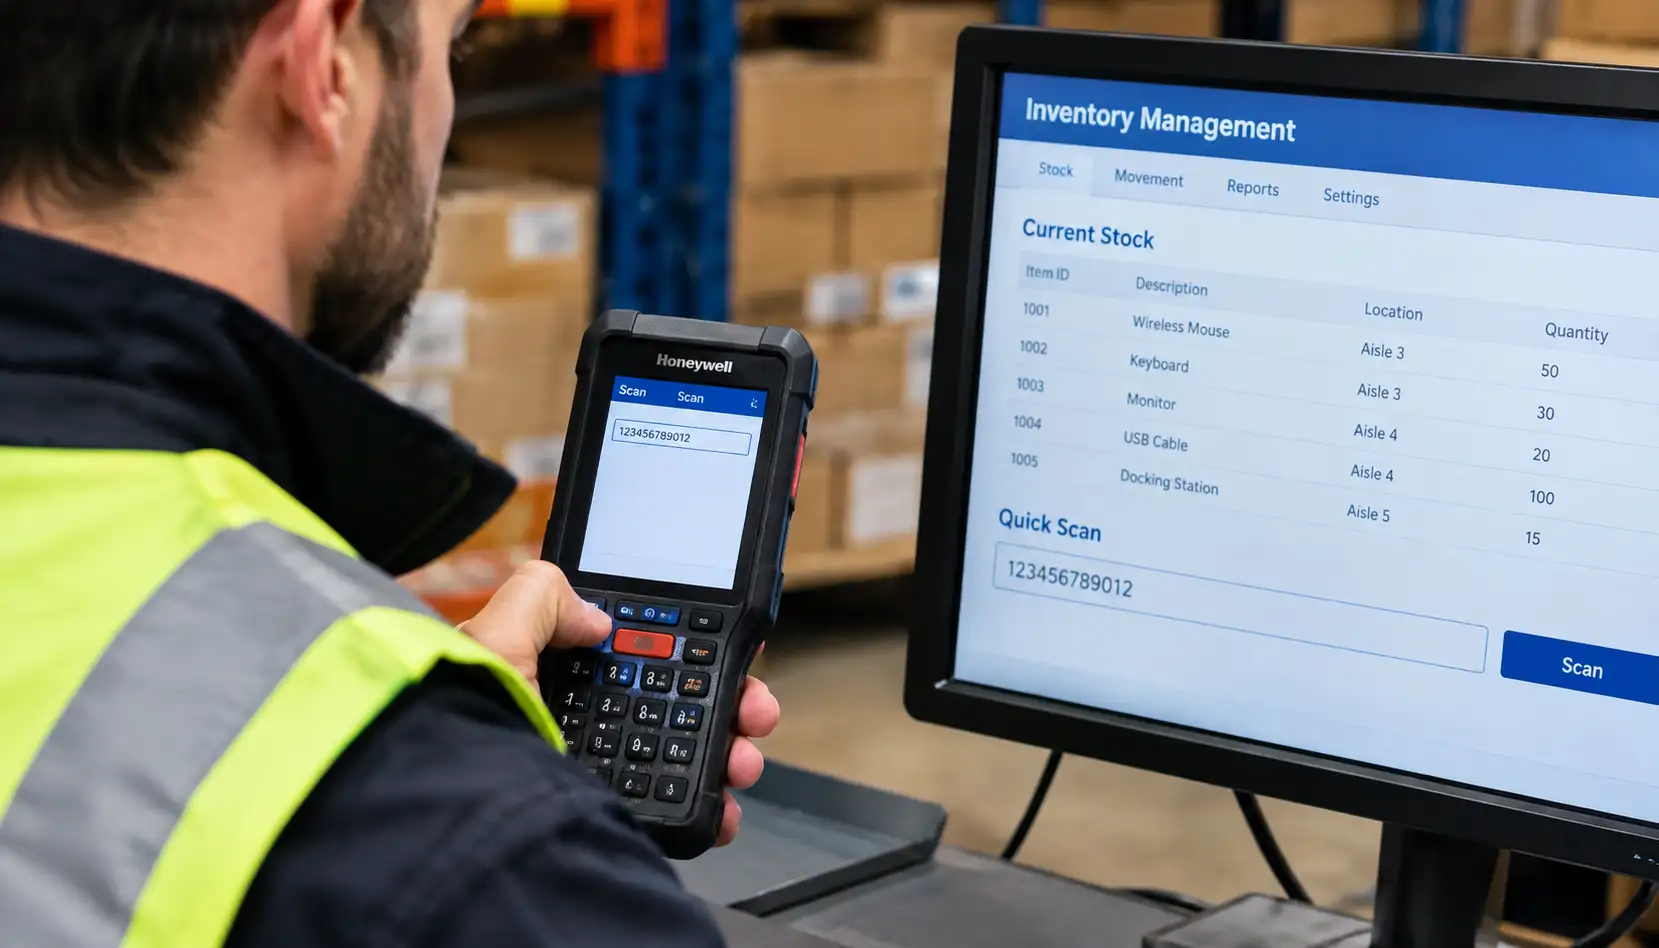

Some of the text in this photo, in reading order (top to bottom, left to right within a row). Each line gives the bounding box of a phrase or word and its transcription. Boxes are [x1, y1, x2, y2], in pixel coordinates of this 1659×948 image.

[1026, 98, 1296, 142] Inventory Management
[1039, 162, 1073, 176] Stock
[1115, 169, 1184, 187] Movement
[1228, 179, 1279, 196] Reports
[1324, 188, 1379, 208] Settings
[1023, 219, 1153, 249] Current Stock
[1026, 265, 1069, 281] Item ID
[1136, 277, 1208, 296] Description
[1024, 302, 1049, 316] 1001
[1365, 303, 1422, 321] Location
[1133, 315, 1229, 338] Wireless Mouse
[1546, 323, 1608, 345] Quantity
[1021, 341, 1047, 354] 1002
[1361, 343, 1405, 360] Aisle 3
[657, 354, 733, 373] Honeywell
[1131, 354, 1189, 373] Keyboard
[1542, 364, 1558, 378] 50
[619, 385, 646, 396] Scan
[1017, 377, 1044, 392] 1003
[1357, 384, 1401, 401] Aisle 3
[678, 391, 704, 403] Scan
[1127, 393, 1176, 410] Monitor
[1537, 406, 1554, 420] 30
[1014, 415, 1041, 429] 1004
[619, 426, 691, 443] 123456789012
[1124, 431, 1188, 451] USB Cable
[1354, 424, 1398, 442] Aisle 4
[1012, 453, 1038, 467] 1005
[1533, 448, 1550, 462] 20
[1351, 464, 1394, 482] Aisle 4
[1121, 469, 1218, 495] Docking Station
[1531, 490, 1554, 505] 100
[1347, 505, 1390, 523] Aisle 5
[999, 509, 1101, 542] Quick Scan
[1526, 532, 1540, 545] 15
[1009, 560, 1132, 597] 123456789012
[1562, 657, 1603, 679] Scan
